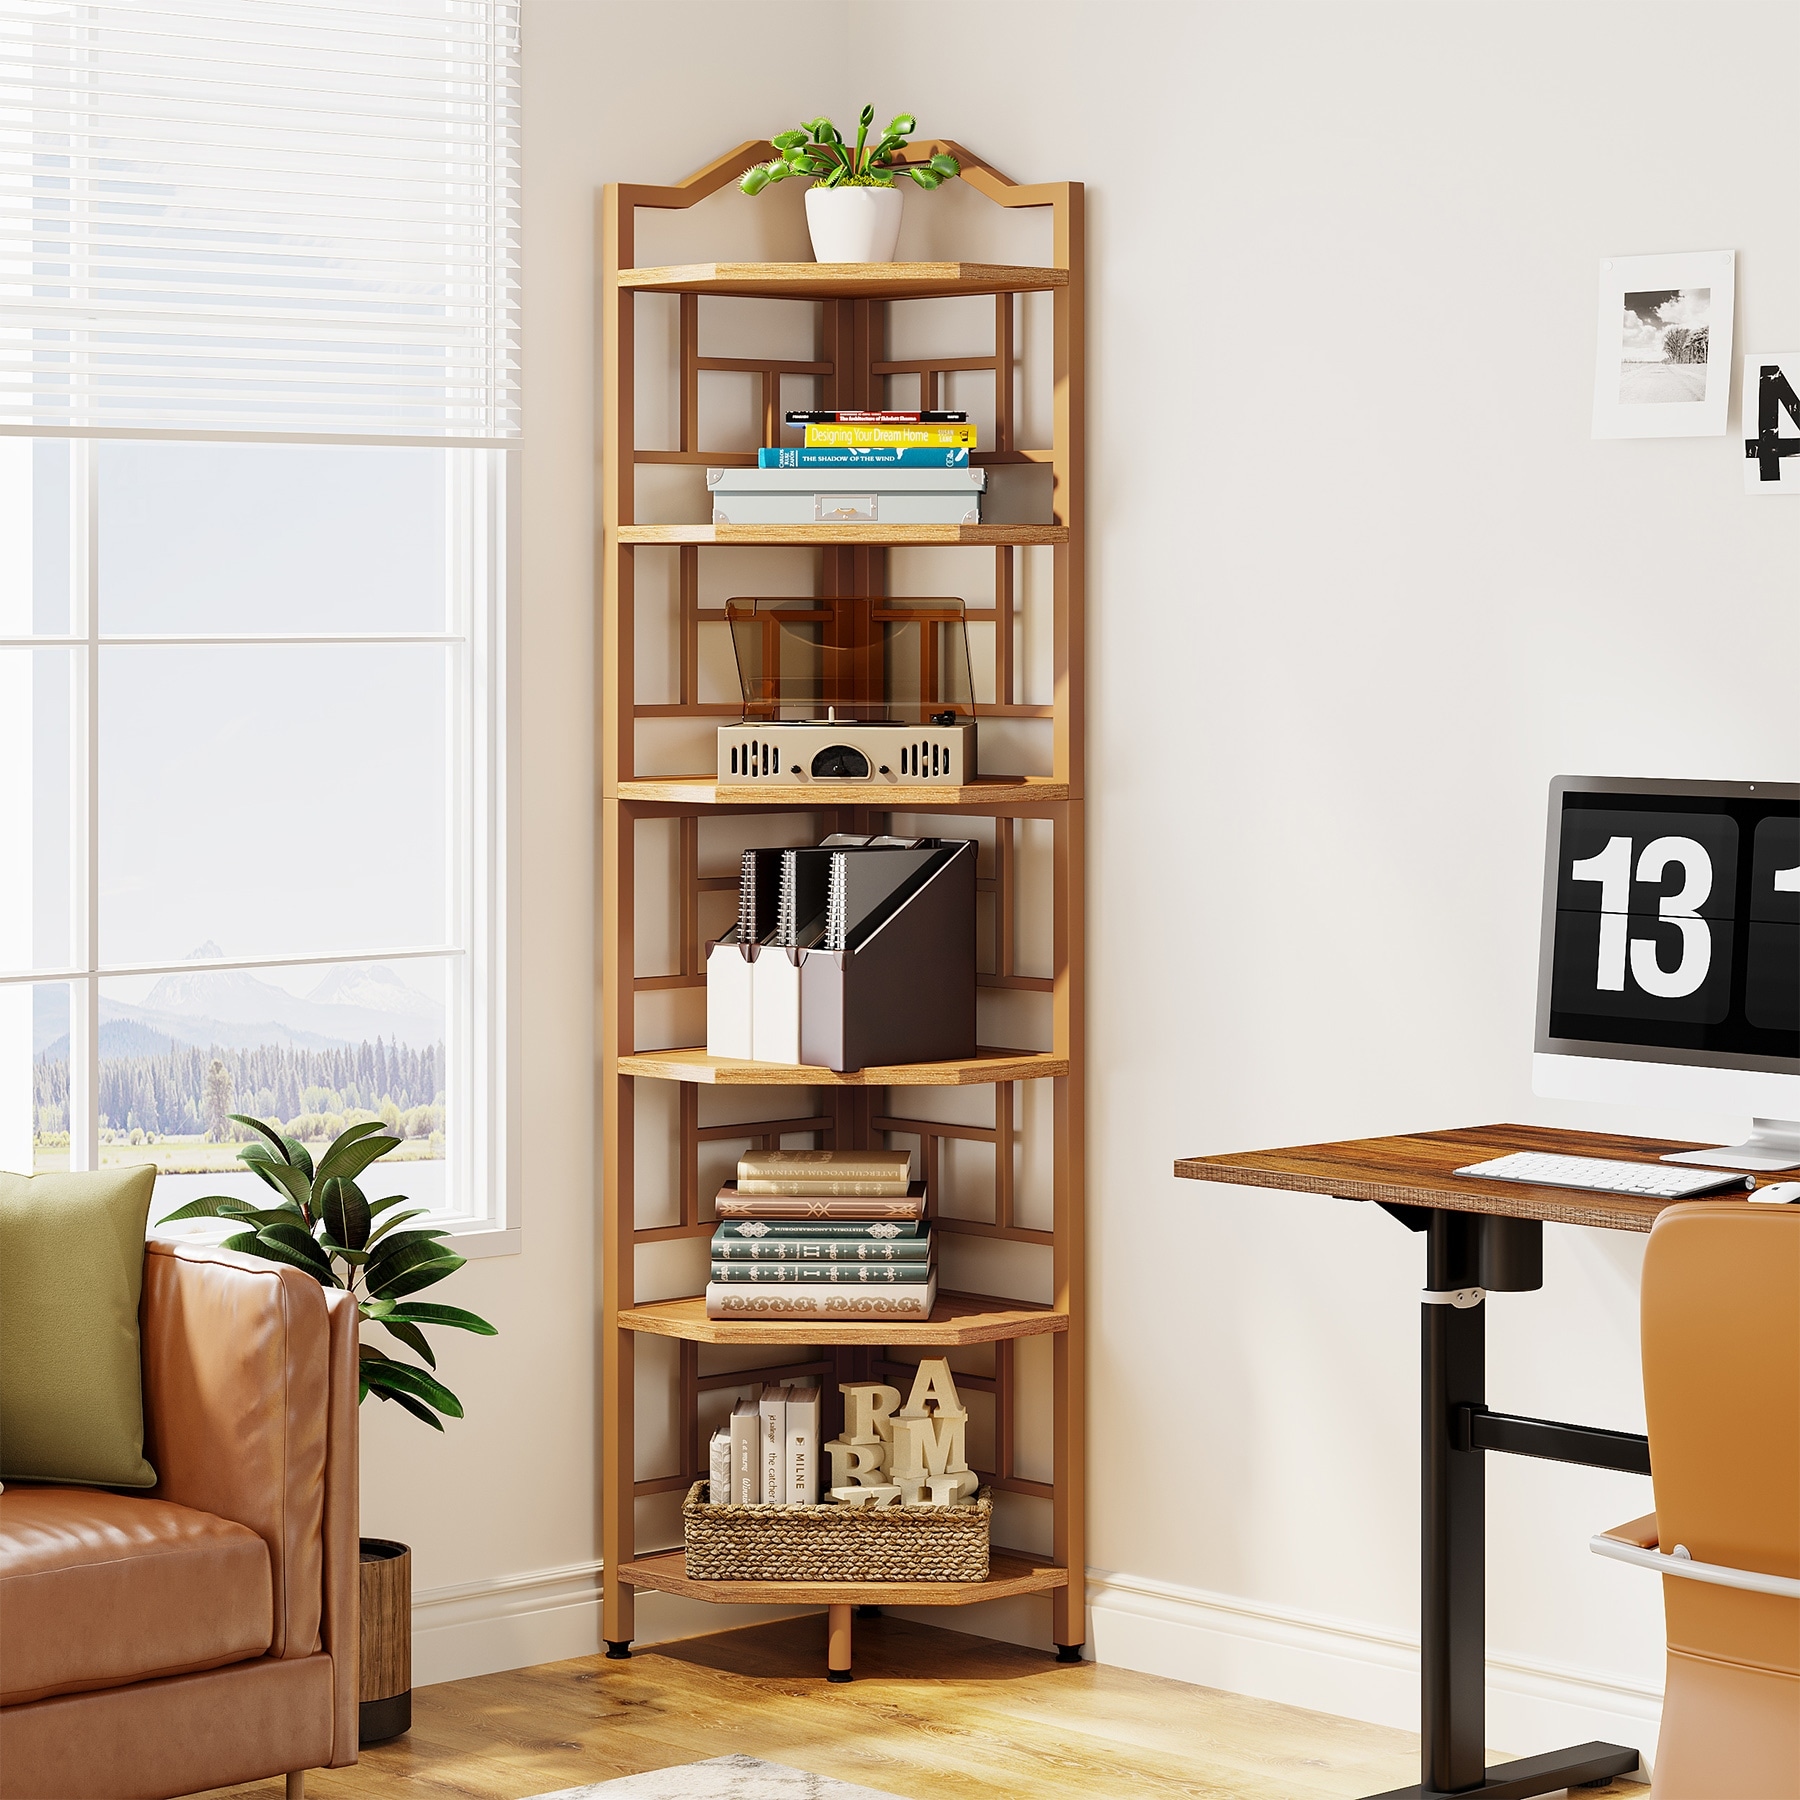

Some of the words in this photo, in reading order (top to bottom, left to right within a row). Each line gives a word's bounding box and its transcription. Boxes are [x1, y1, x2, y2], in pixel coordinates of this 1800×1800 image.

[811, 428, 852, 444] Designing
[854, 428, 872, 442] Your
[873, 428, 901, 442] Dream
[903, 428, 928, 442] Home
[1571, 836, 1713, 998] 13
[900, 1357, 966, 1418] A
[840, 1382, 901, 1445] R
[768, 1452, 777, 1465] the
[889, 1414, 968, 1479] M
[768, 1468, 777, 1498] catcher
[796, 1453, 804, 1489] MILNE
